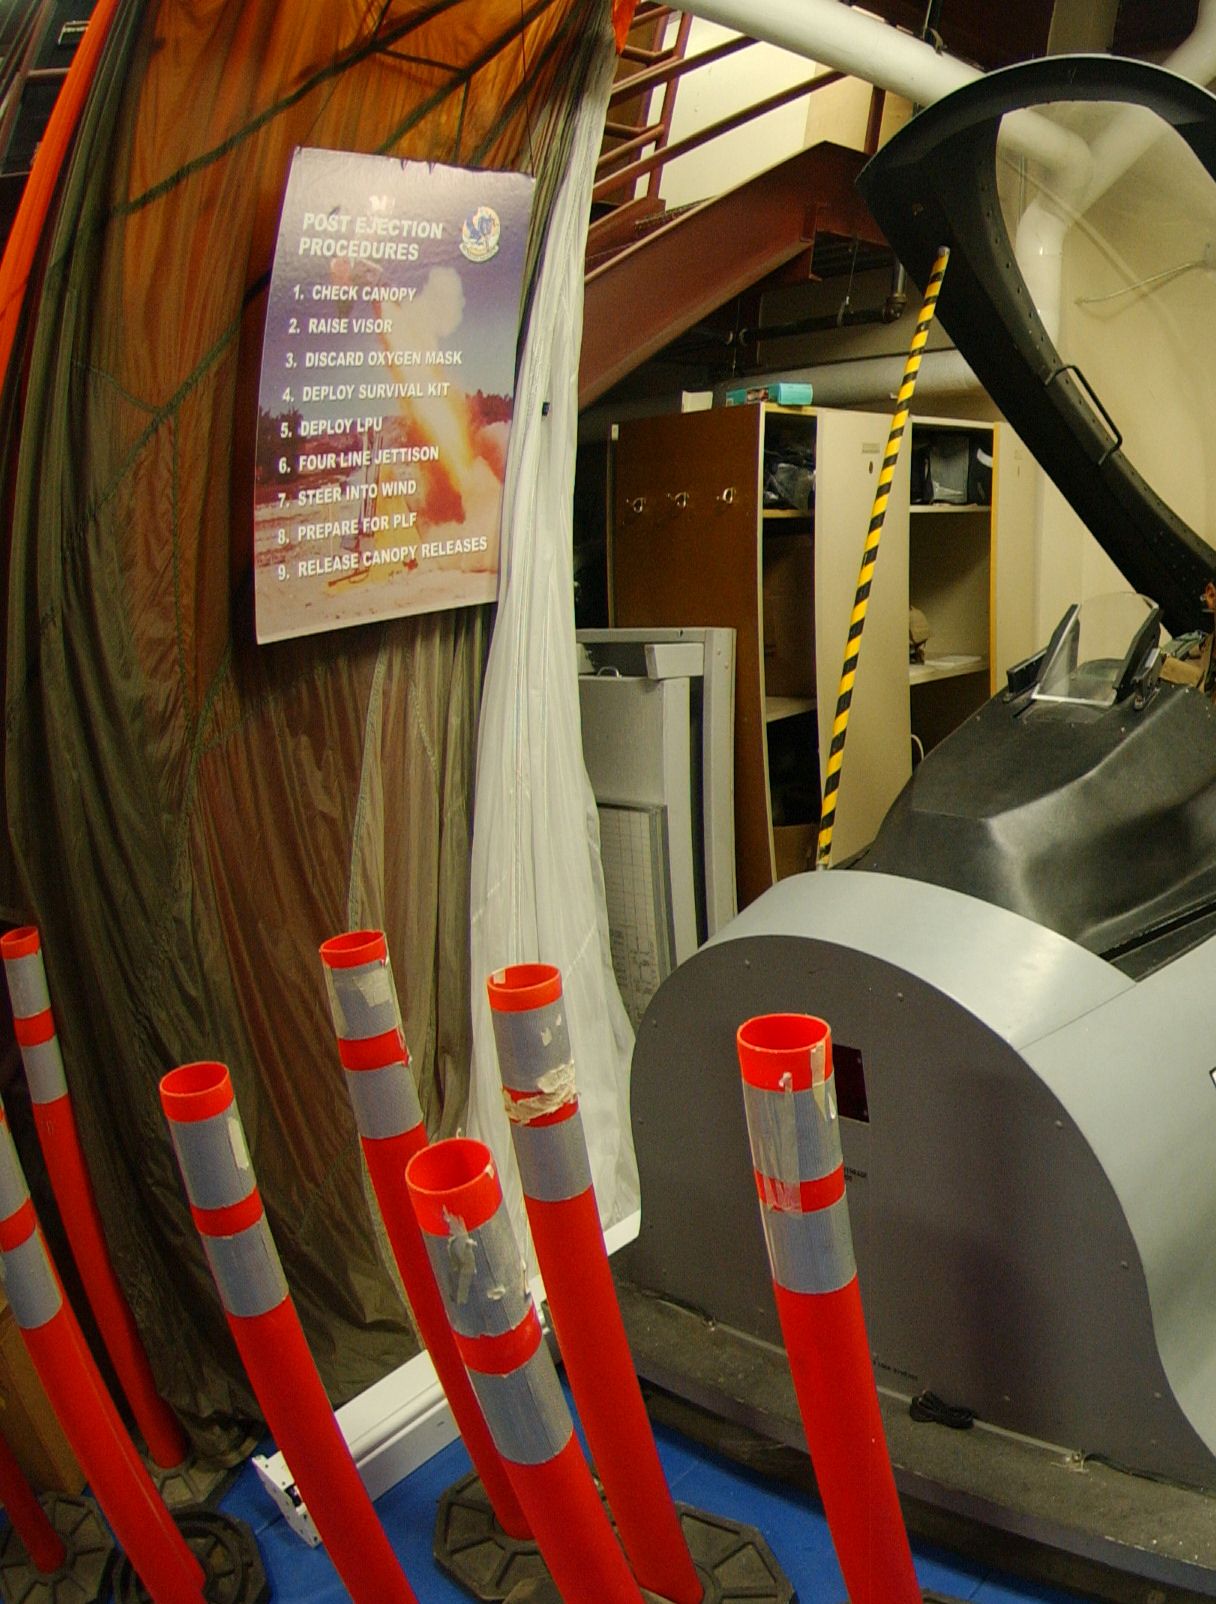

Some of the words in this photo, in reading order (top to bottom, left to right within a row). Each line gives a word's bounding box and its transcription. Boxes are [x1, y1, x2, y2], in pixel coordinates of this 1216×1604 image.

[302, 212, 351, 232] POST
[355, 217, 444, 239] EJECTION
[298, 238, 419, 261] PROCEDURES
[293, 285, 304, 300] 1.
[312, 285, 358, 301] CHECK
[362, 287, 417, 301] CANOPY
[288, 319, 300, 334] 2.
[308, 318, 349, 333] RAISE
[352, 318, 393, 333] VISOR
[285, 353, 297, 368] 3.
[305, 352, 364, 368] DISCARD
[368, 351, 421, 366] OXYGEN
[425, 351, 463, 365] MASK
[282, 387, 294, 402] 4.
[303, 385, 355, 402] DEPLOY
[358, 384, 424, 399] SURVIVAL
[428, 382, 450, 397] KIT
[280, 423, 292, 438] 5.
[300, 418, 353, 437] DEPLOY
[356, 416, 383, 433] LPU
[278, 458, 291, 474] 6.
[299, 452, 336, 471] FOUR
[340, 450, 371, 468] LINE
[374, 446, 439, 465] JETTISON
[278, 493, 290, 508] 7.
[298, 487, 342, 507] STEER
[346, 484, 378, 502] INTO
[381, 480, 417, 497] WIND
[277, 529, 290, 545] 8.
[298, 519, 359, 542] PREPARE
[362, 515, 389, 534] FOR
[393, 512, 417, 529] PLF
[277, 565, 290, 581] 9.
[298, 553, 359, 577] RELEASE
[362, 545, 418, 567] CANOPY
[421, 536, 488, 560] RELEASES
